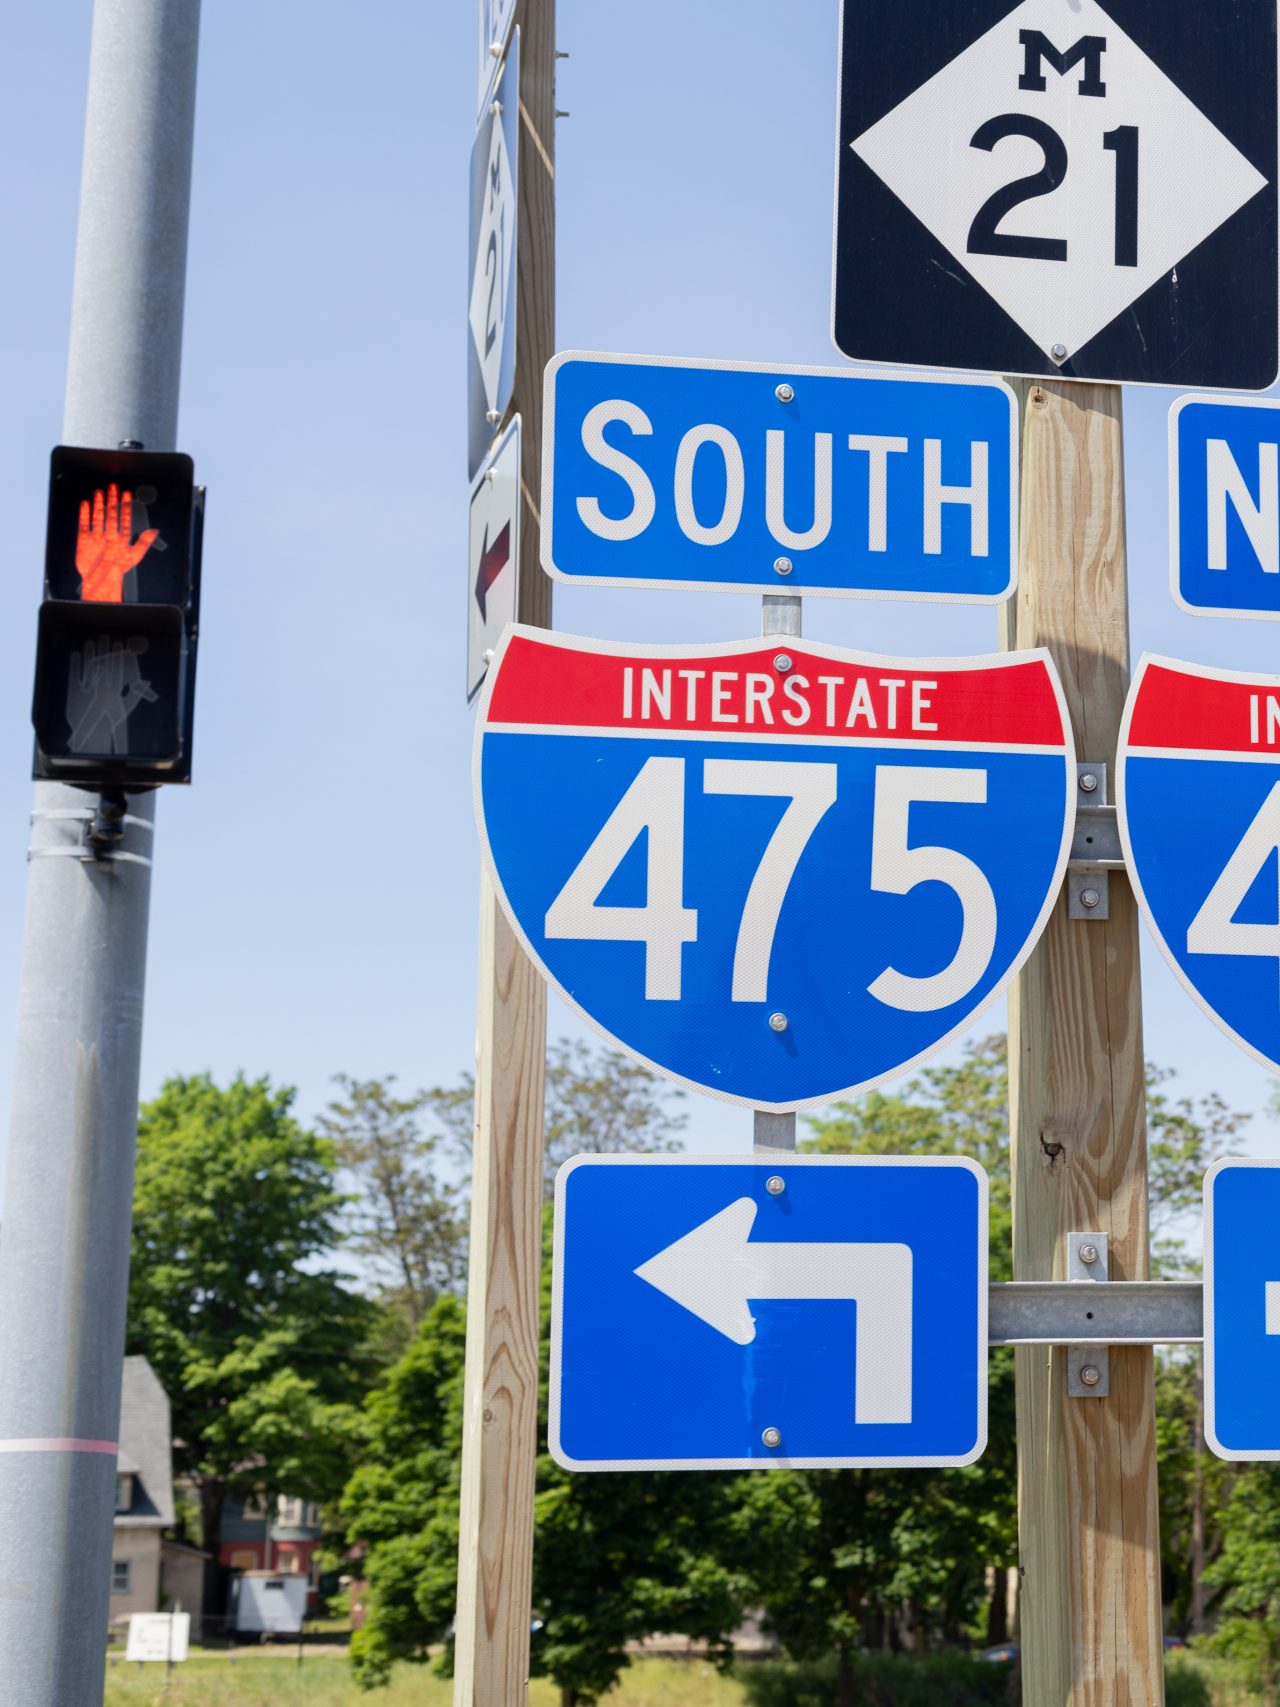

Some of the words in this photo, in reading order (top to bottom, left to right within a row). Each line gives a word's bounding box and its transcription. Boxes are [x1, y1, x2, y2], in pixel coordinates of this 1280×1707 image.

[1018, 28, 1107, 98] M
[490, 141, 501, 214] M
[966, 112, 1139, 268] 21
[484, 201, 504, 361] 21
[576, 399, 989, 557] SOUTH
[622, 667, 938, 731] INTERSTATE
[544, 756, 998, 1012] 475
